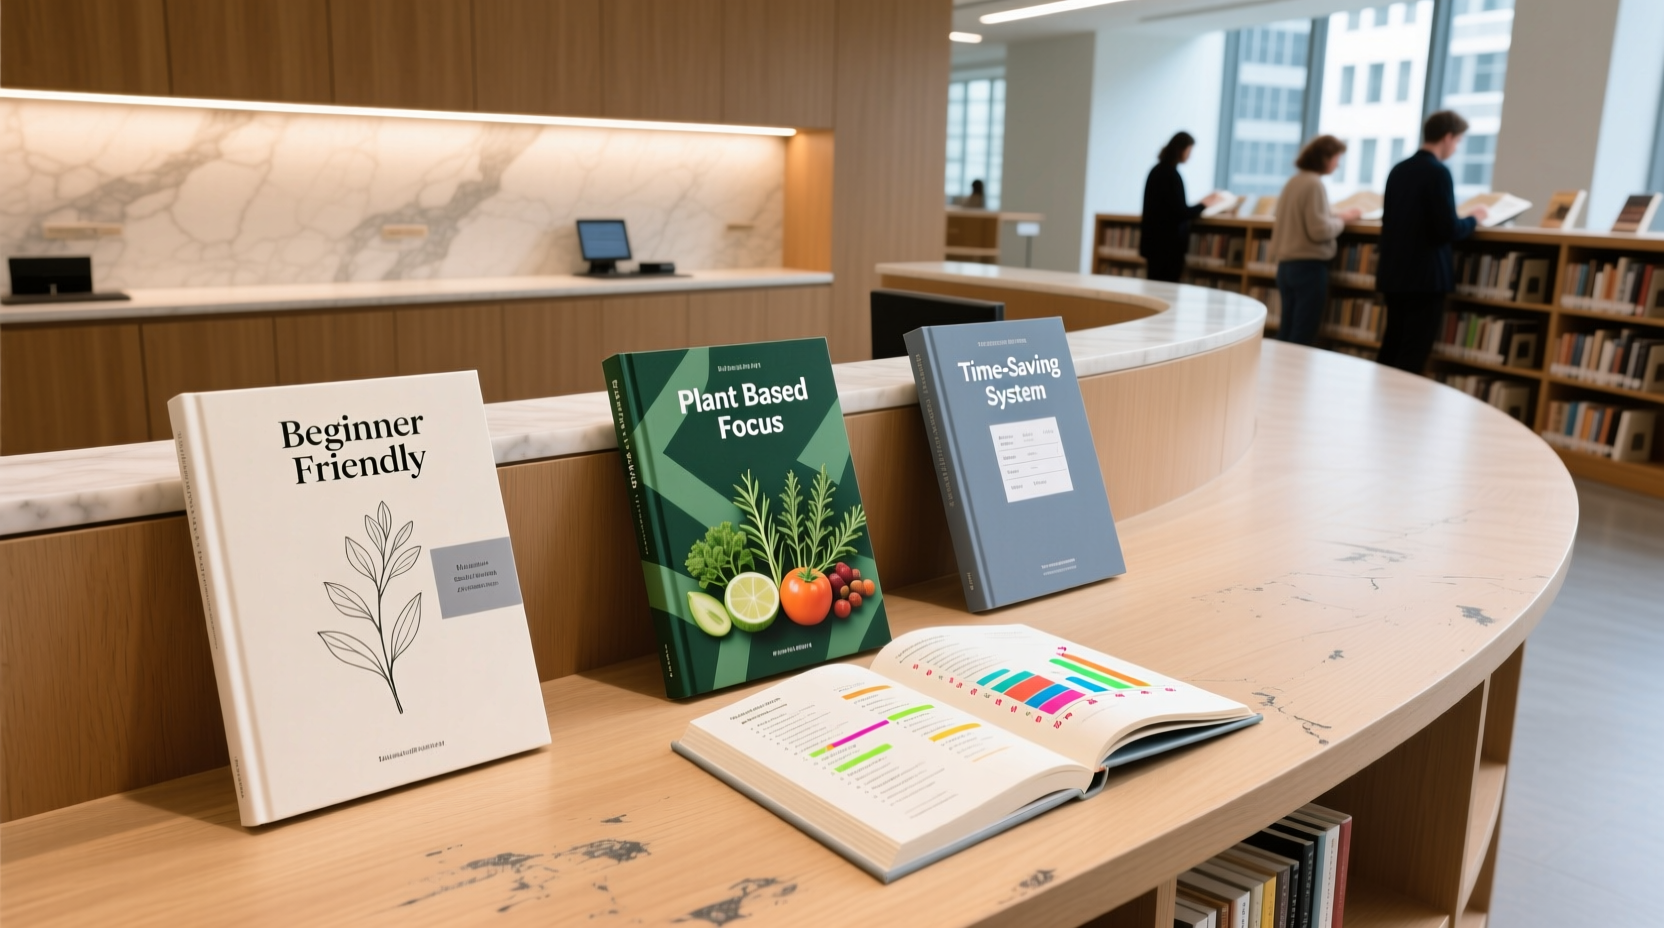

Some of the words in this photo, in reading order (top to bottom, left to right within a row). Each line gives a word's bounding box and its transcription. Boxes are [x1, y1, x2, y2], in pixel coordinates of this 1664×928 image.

[957, 354, 1062, 382] Time-Saving
[677, 386, 739, 414] Plant
[741, 376, 809, 406] Based
[985, 383, 1047, 410] System
[279, 414, 424, 452] Beginner
[717, 414, 784, 439] Focus
[291, 442, 426, 485] Friendly
